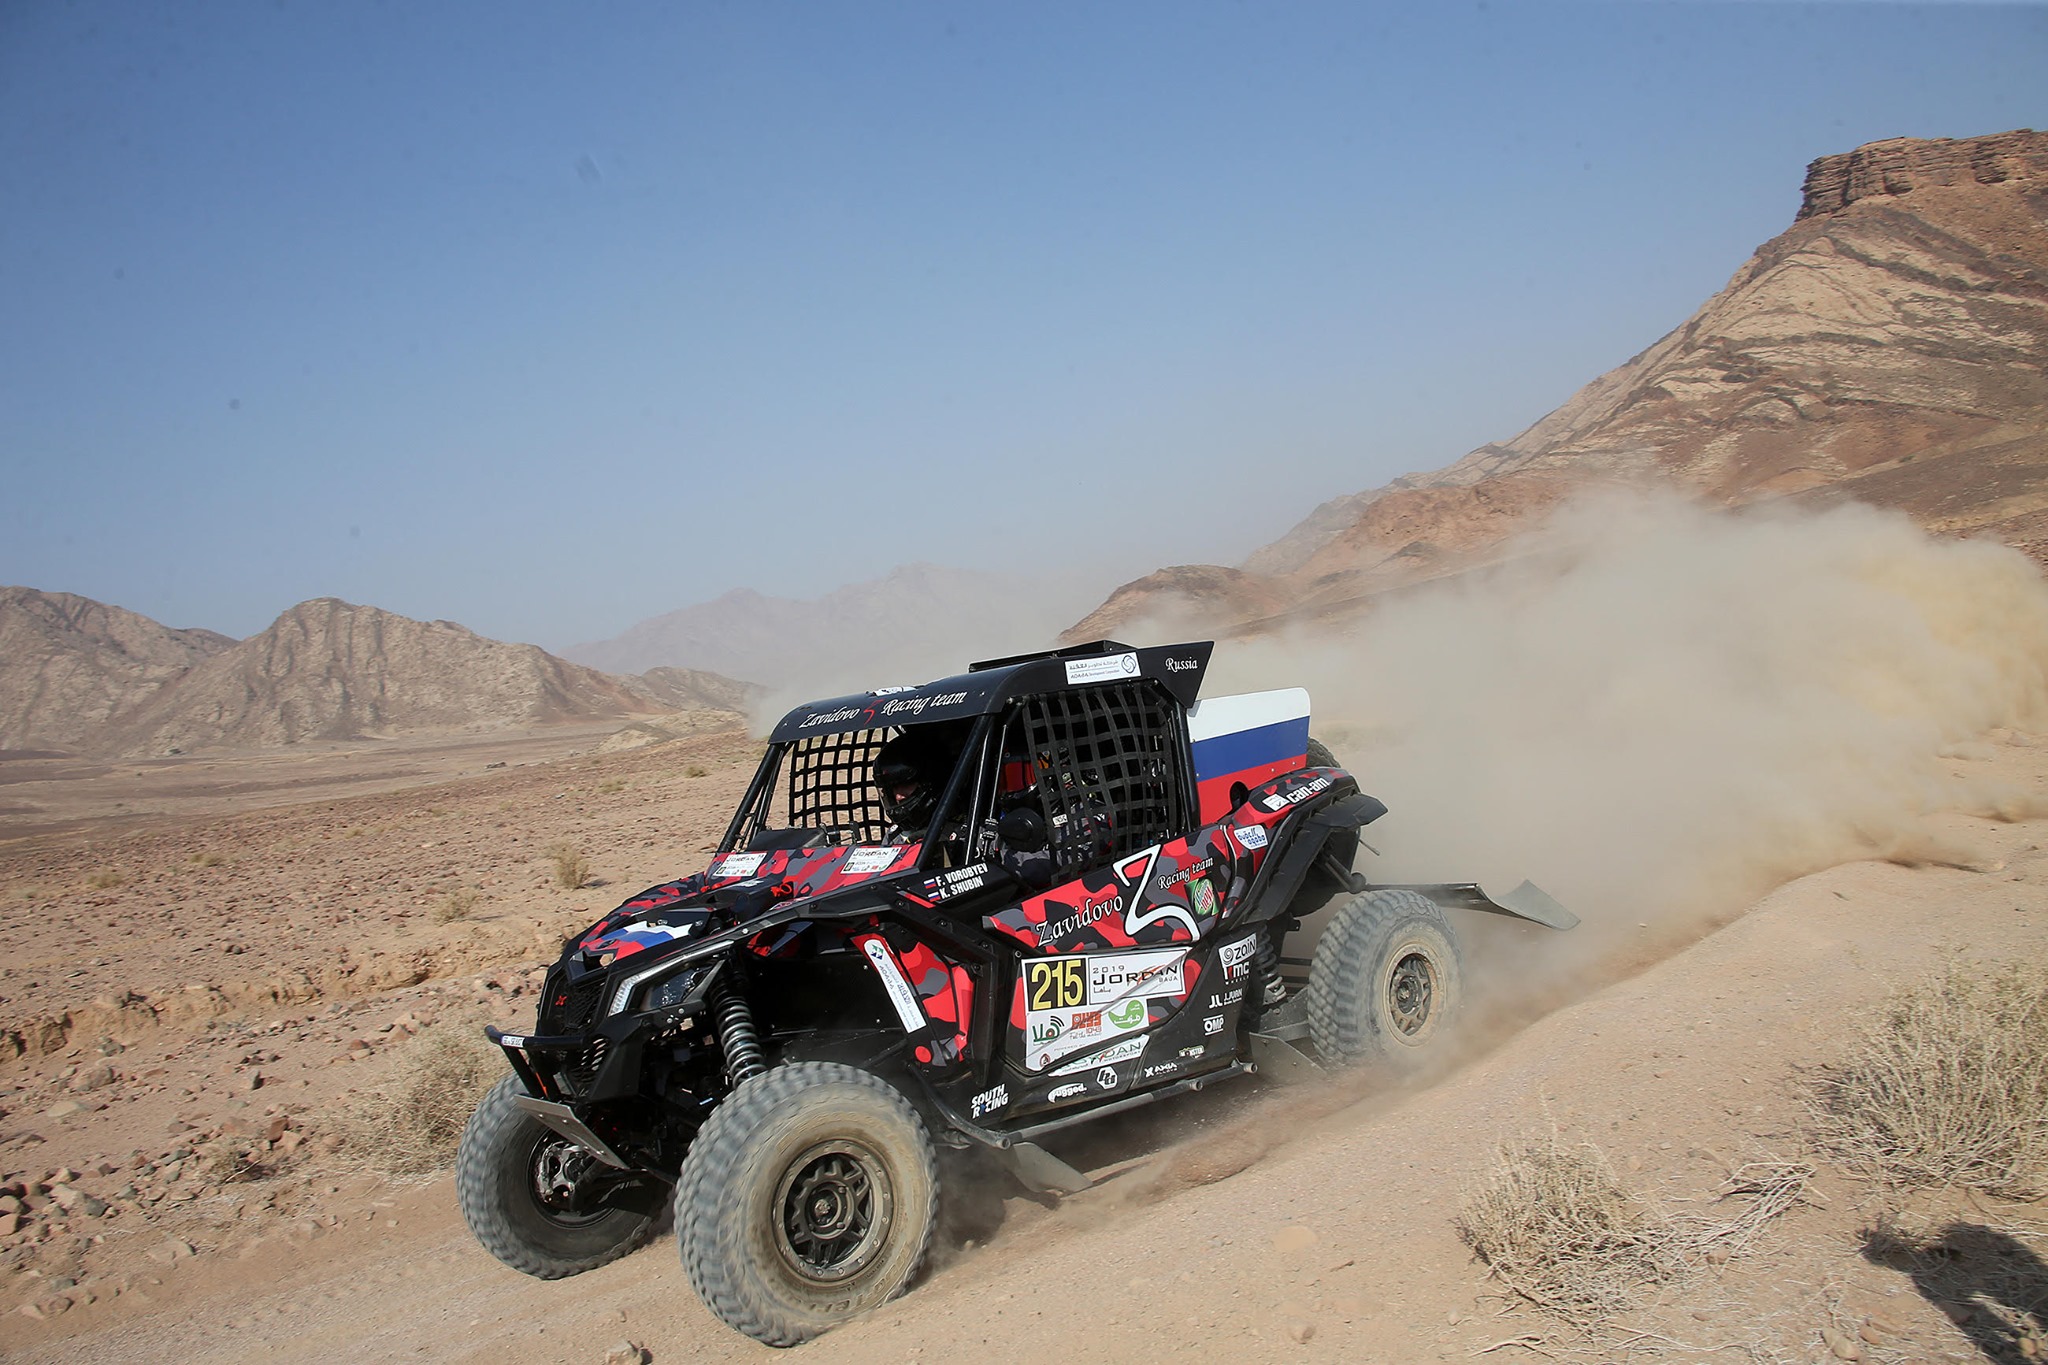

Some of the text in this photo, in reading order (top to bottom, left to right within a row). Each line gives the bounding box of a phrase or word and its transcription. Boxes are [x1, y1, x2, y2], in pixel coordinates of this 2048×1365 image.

[1165, 656, 1198, 673] Russia
[798, 690, 968, 729] Zavidovo Racing team
[1286, 777, 1330, 803] can-am
[935, 862, 988, 887] F. VOROBYEV
[1157, 856, 1214, 890] Racing team
[939, 875, 984, 899] K. SHUBIN
[1035, 896, 1123, 947] Zavidovo
[1092, 965, 1125, 974] 2019
[1093, 965, 1178, 986] JORDAN
[1031, 959, 1084, 1011] 215
[1204, 1017, 1224, 1032] OMP
[970, 1083, 1005, 1109] SOUTH
